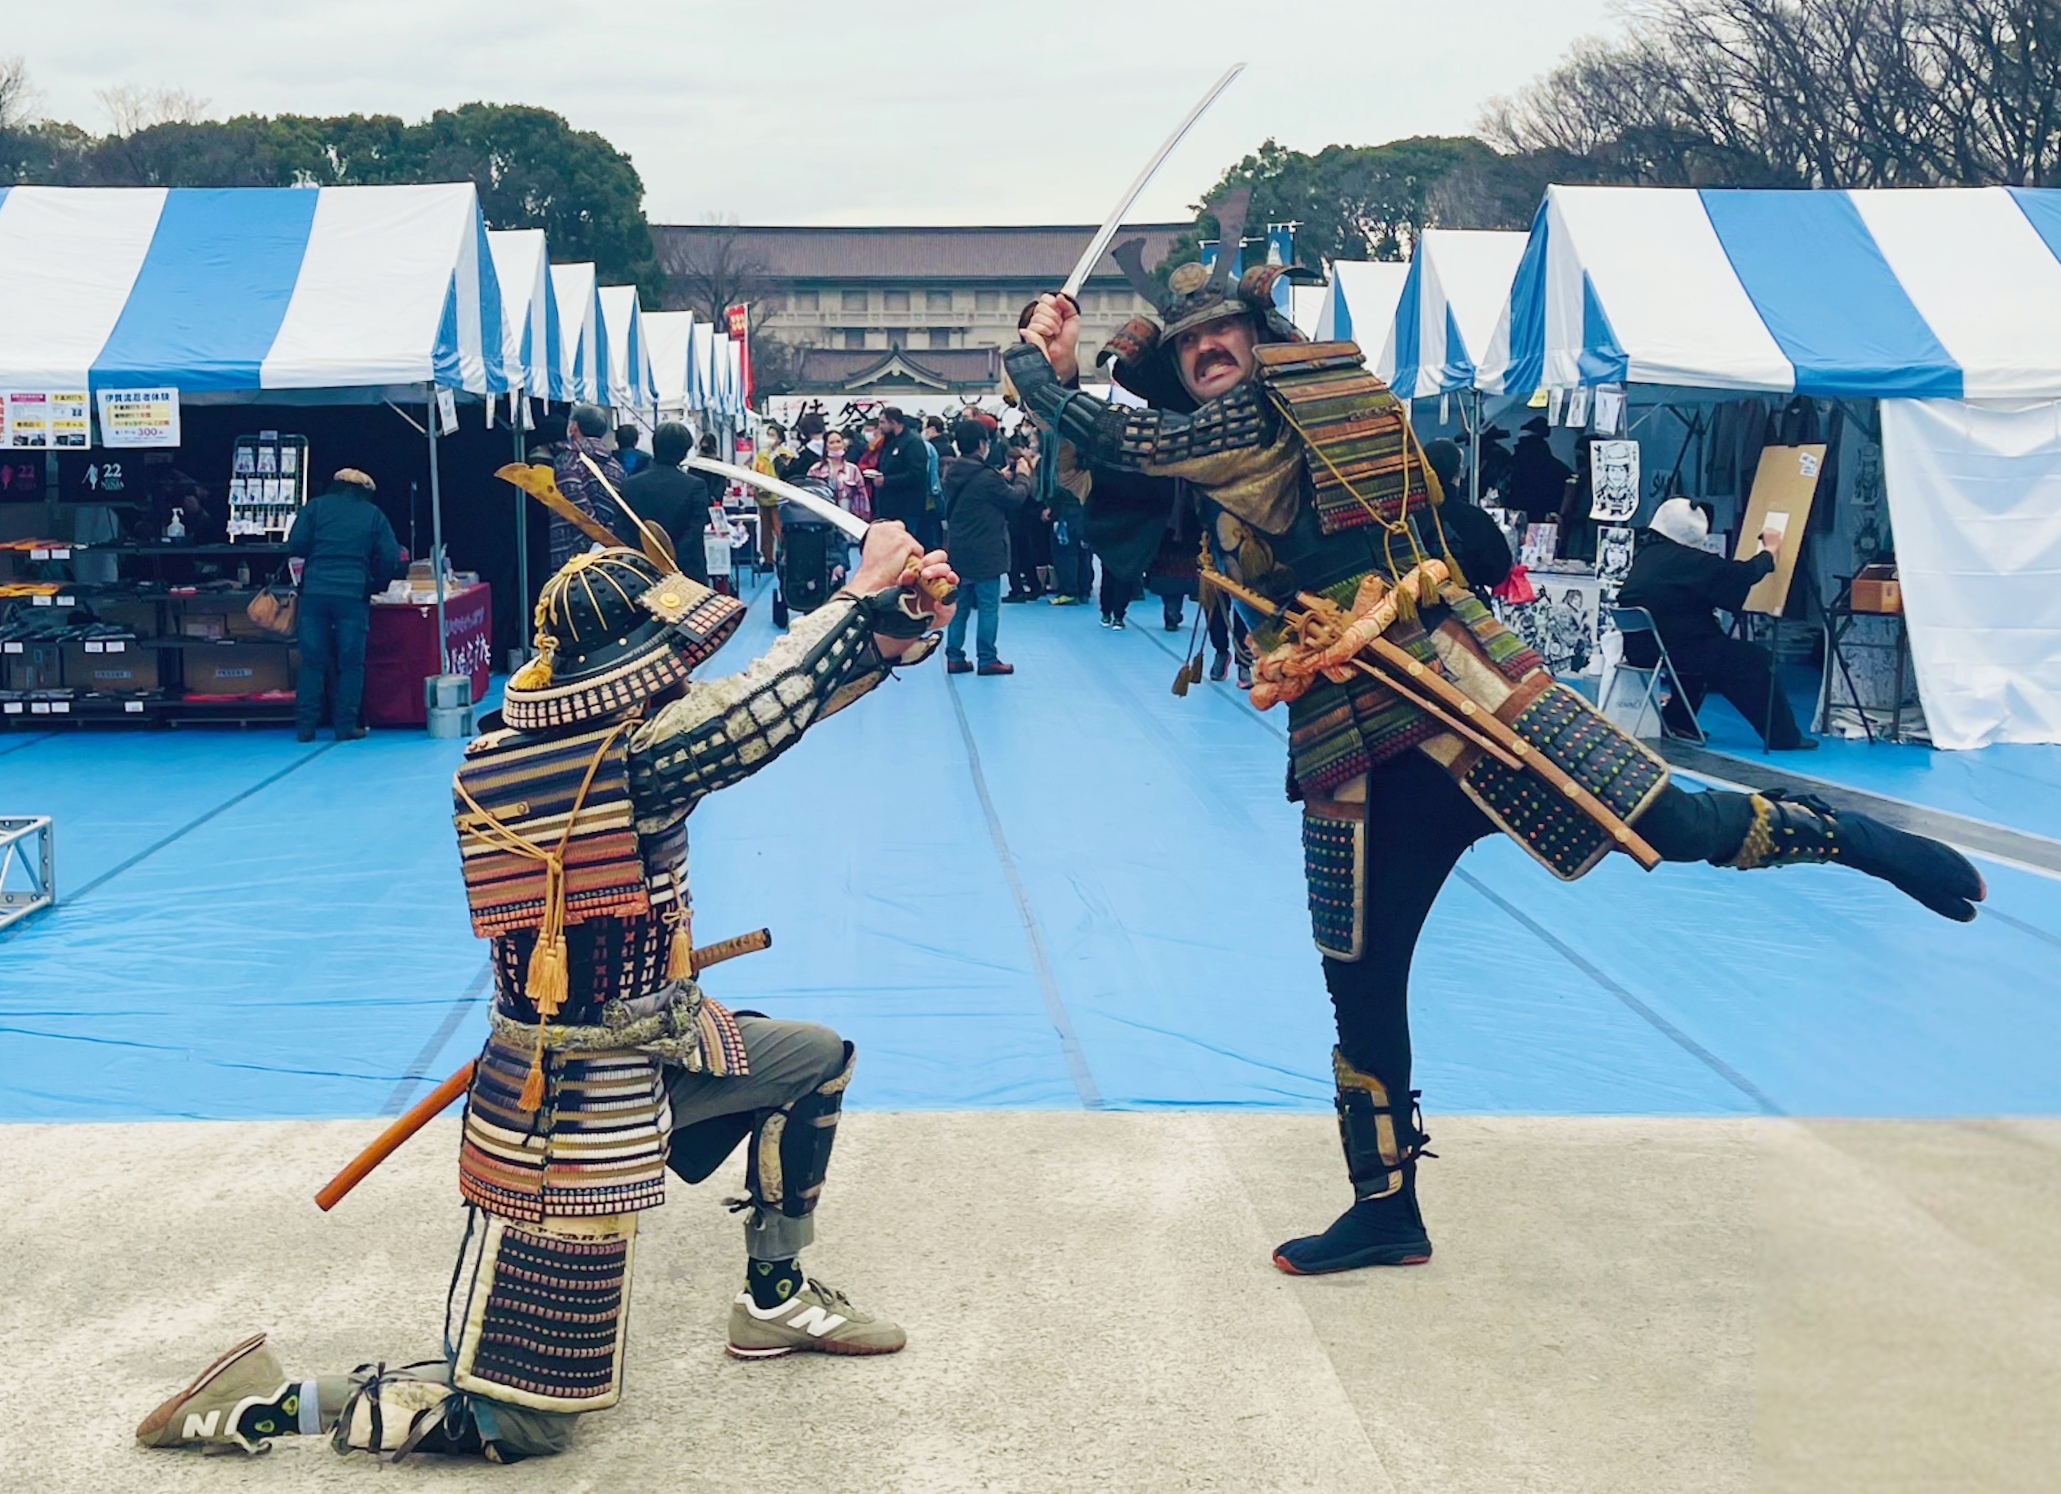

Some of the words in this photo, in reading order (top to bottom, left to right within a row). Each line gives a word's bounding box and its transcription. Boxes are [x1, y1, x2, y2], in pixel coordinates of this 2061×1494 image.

[103, 463, 122, 478] 22
[786, 1305, 848, 1338] N
[182, 1410, 221, 1439] N
